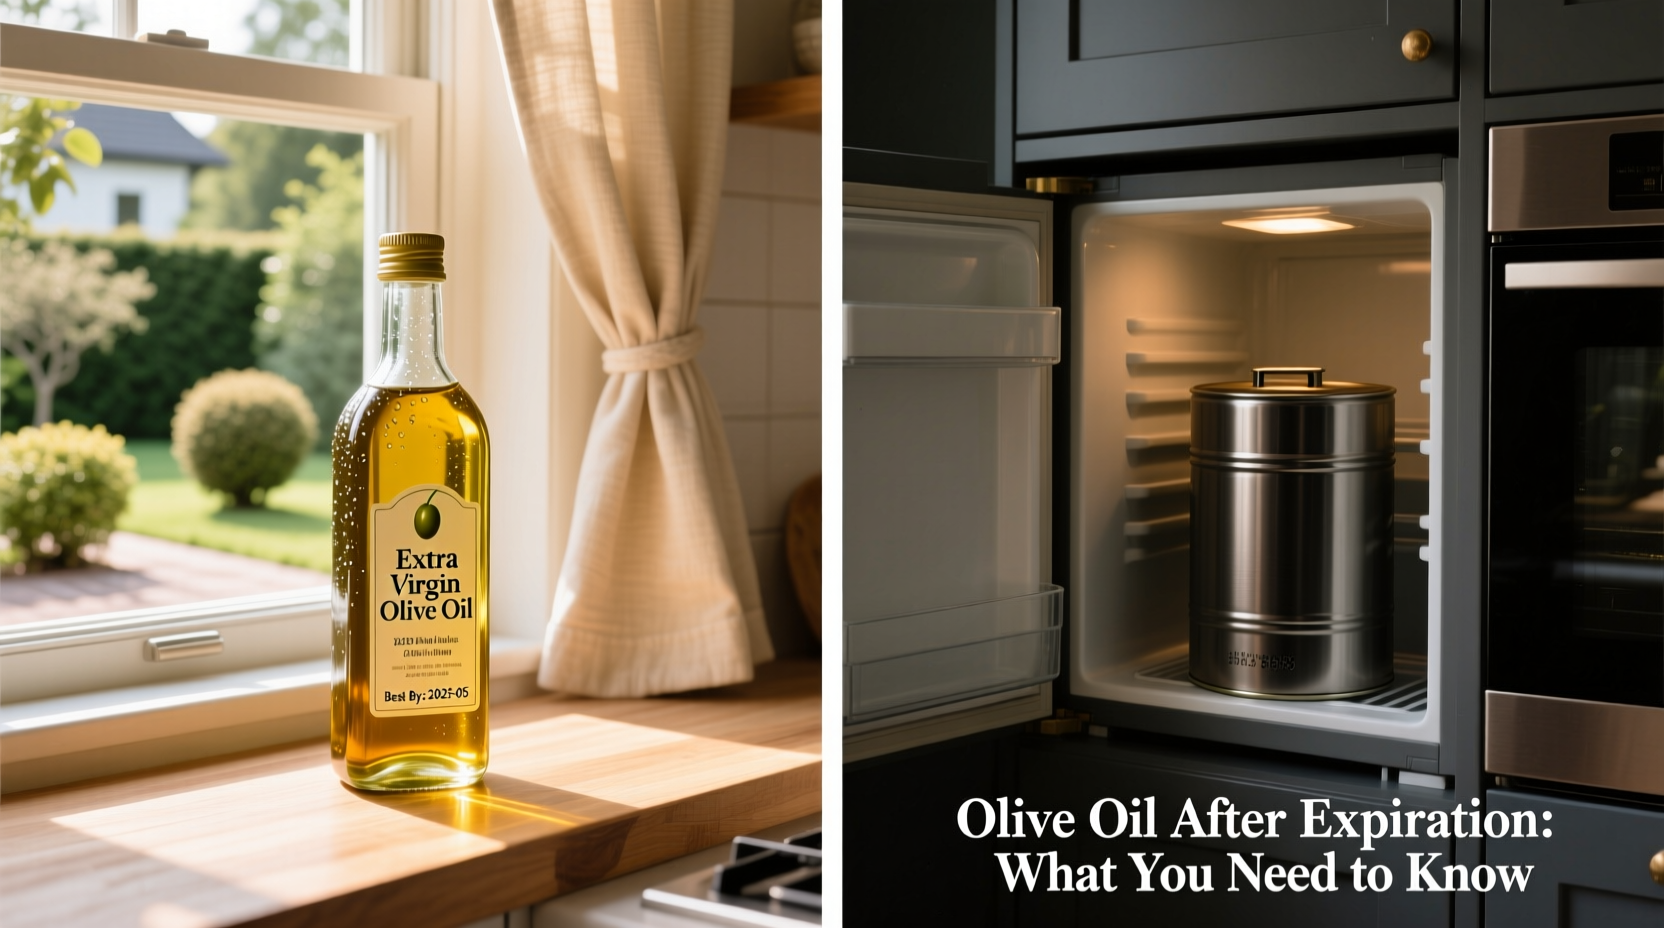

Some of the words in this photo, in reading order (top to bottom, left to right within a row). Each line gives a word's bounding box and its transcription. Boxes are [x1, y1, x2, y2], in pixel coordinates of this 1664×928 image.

[395, 548, 458, 570] Extra
[390, 573, 461, 601] Virgin
[380, 600, 437, 621] Olive
[441, 597, 473, 619] Oil
[409, 690, 426, 704] By:
